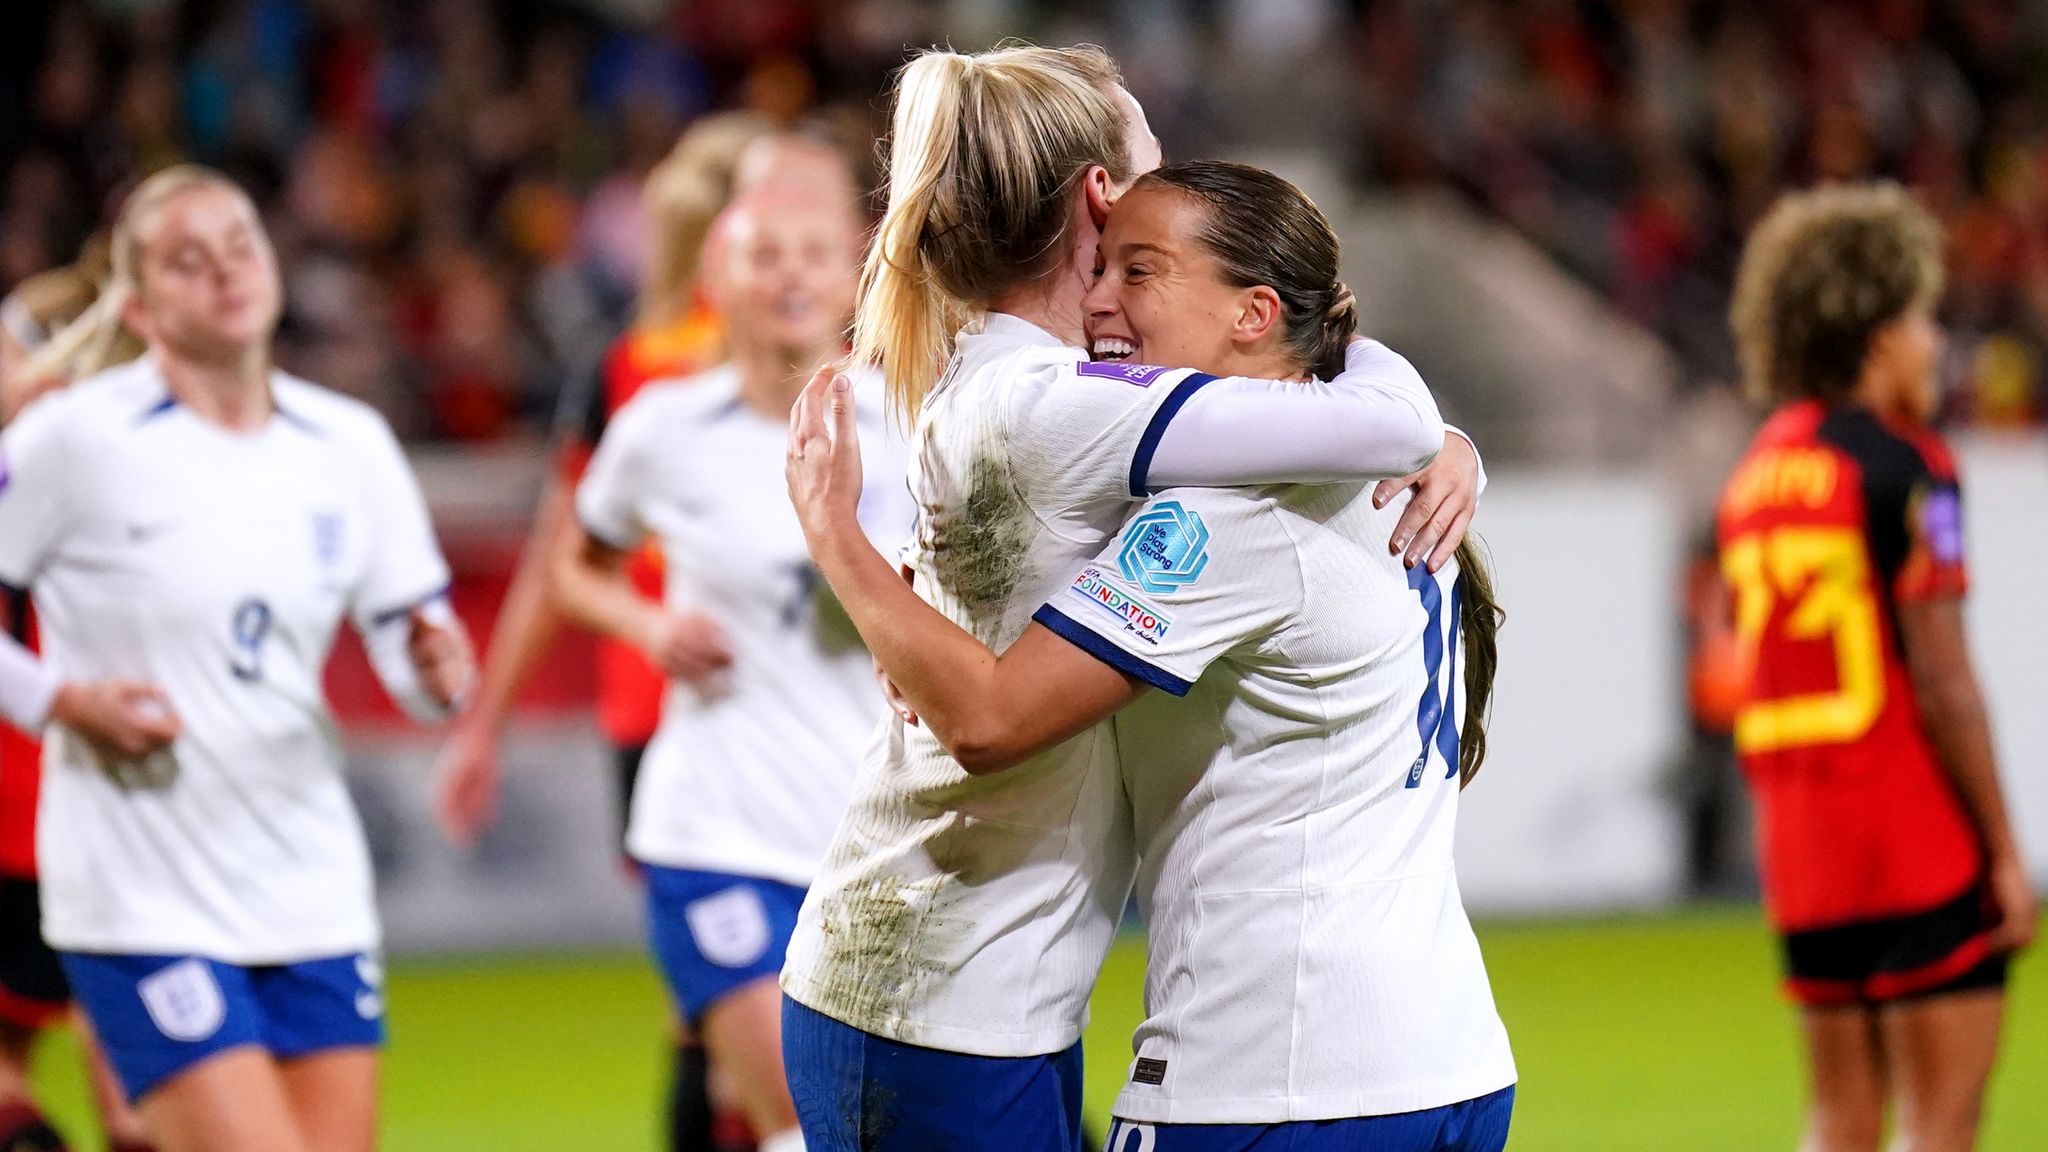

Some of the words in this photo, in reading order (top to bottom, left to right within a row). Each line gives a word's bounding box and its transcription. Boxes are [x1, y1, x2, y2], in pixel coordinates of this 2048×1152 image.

[1153, 524, 1166, 538] We
[1140, 543, 1172, 569] Strong
[1083, 567, 1100, 580] UEFA
[1123, 622, 1136, 631] for
[229, 599, 272, 683] 9
